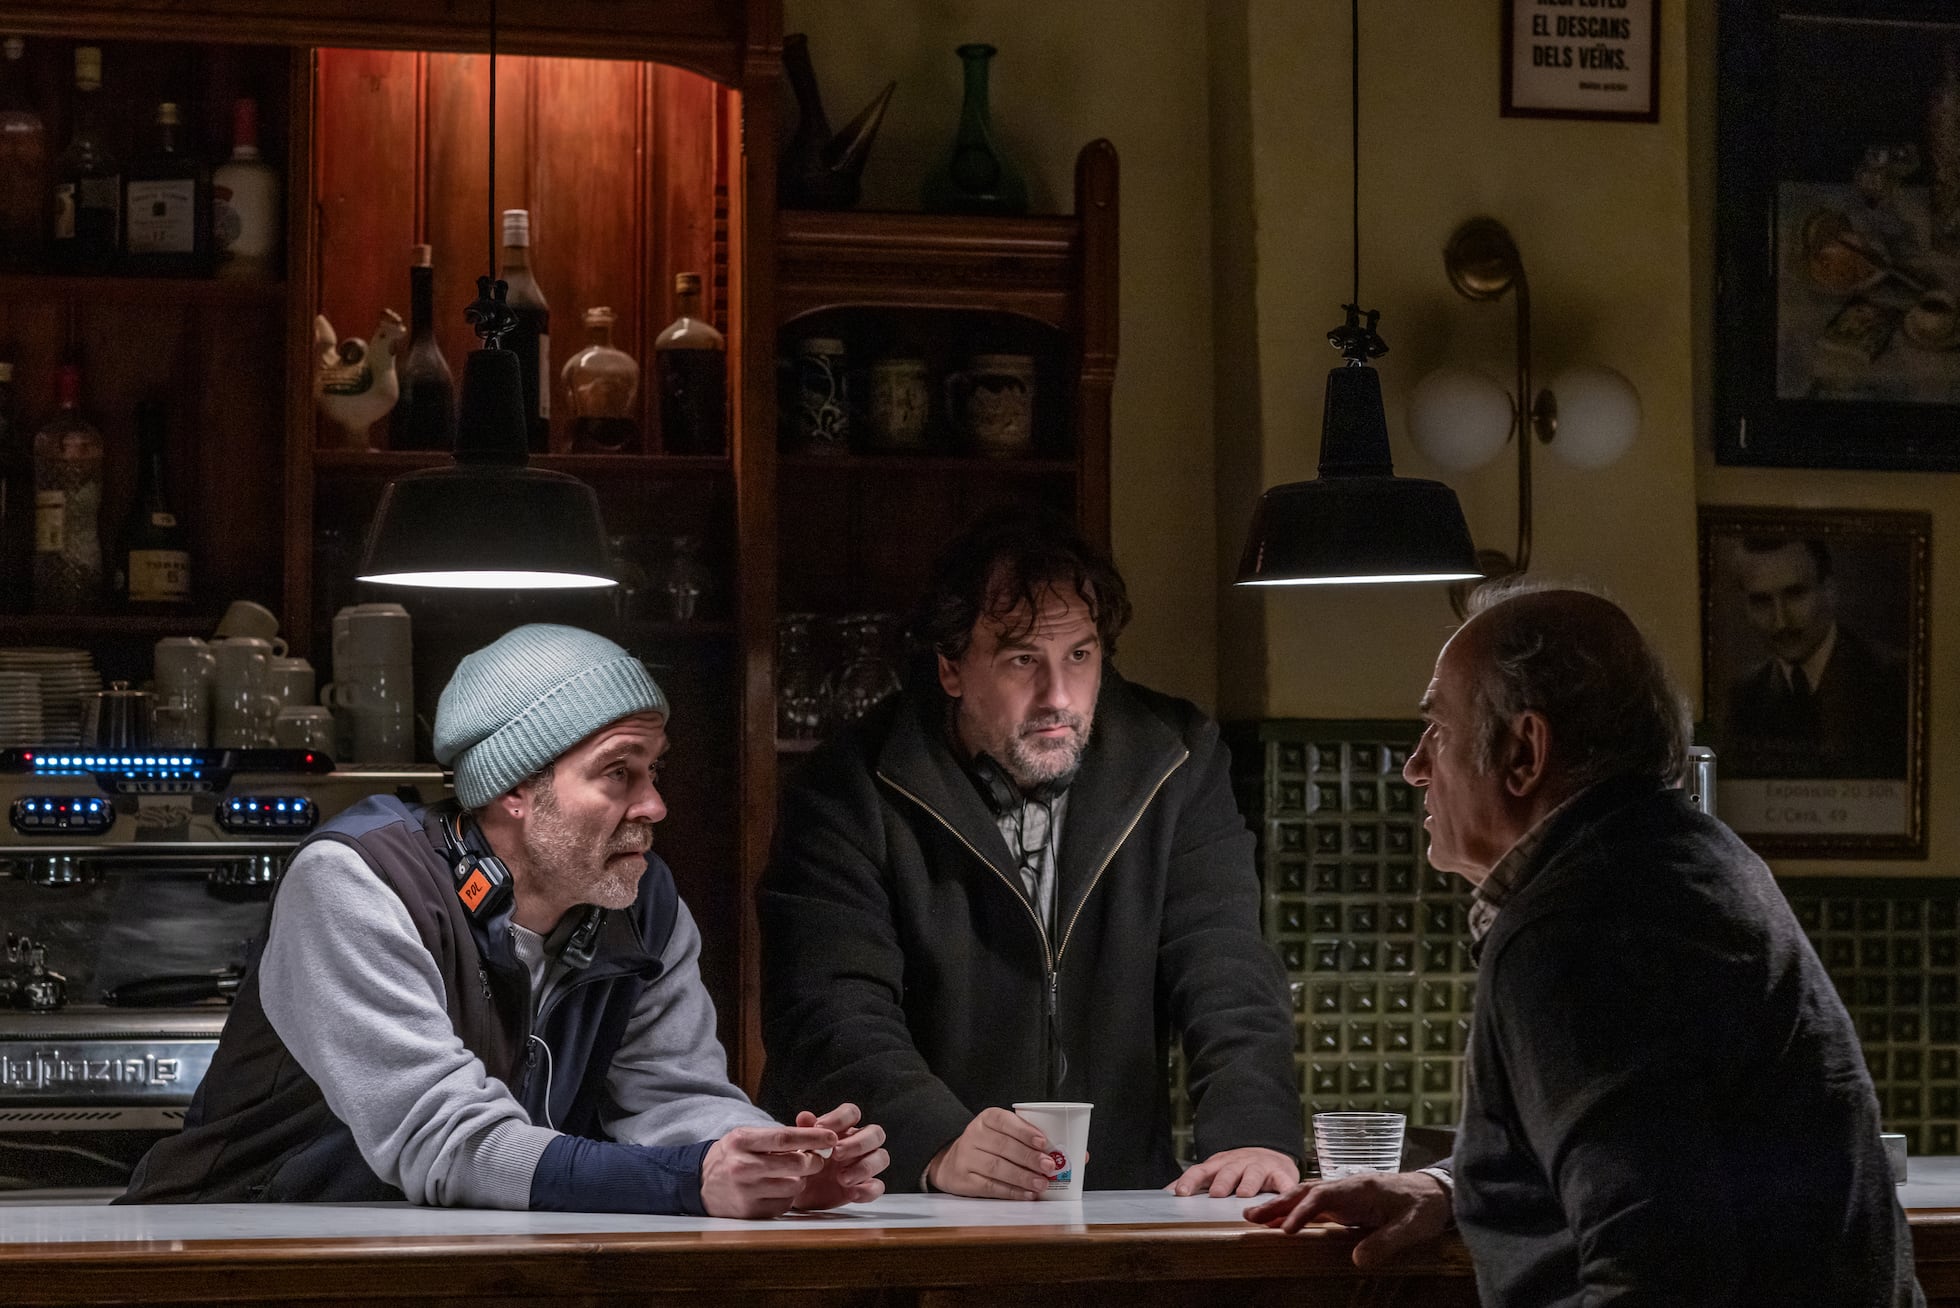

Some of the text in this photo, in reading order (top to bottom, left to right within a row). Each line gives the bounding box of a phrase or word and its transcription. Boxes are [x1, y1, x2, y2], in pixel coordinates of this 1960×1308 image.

[1532, 14, 1630, 40] EL DESCANS
[1533, 43, 1630, 71] DELS VEÏNS.
[465, 881, 483, 900] POL
